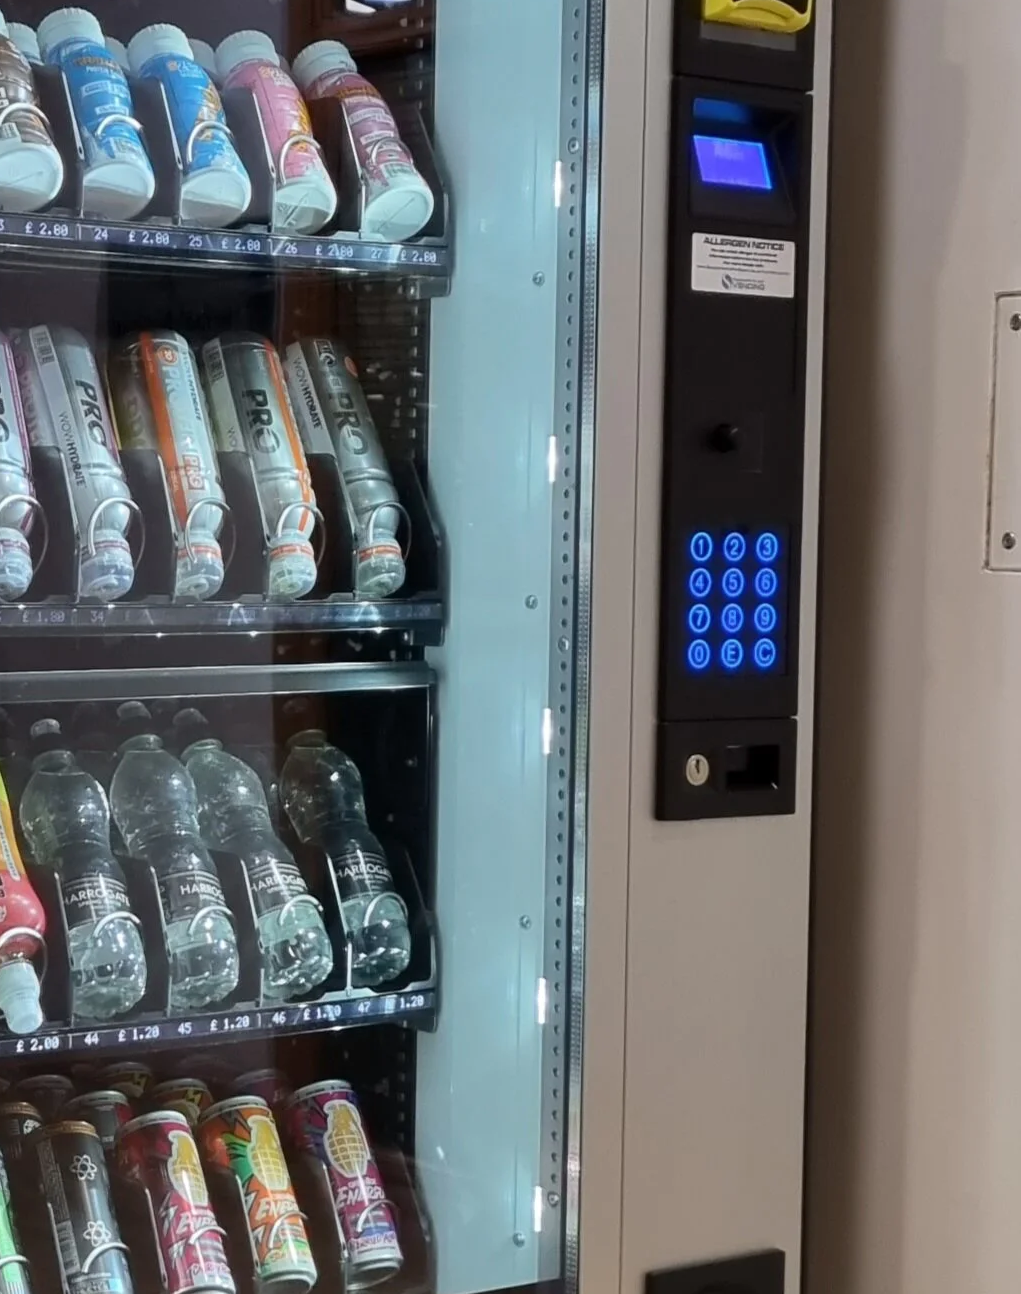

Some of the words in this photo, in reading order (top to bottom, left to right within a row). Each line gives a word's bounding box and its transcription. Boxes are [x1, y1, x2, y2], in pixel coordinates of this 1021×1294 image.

[94, 227, 108, 240] 24
[189, 235, 202, 247] 25
[285, 242, 298, 254] 26
[703, 237, 751, 248] ALLERGEN
[752, 241, 784, 251] NOTICE
[293, 357, 322, 430] WOWHYDRATE
[75, 379, 107, 448] PRO
[242, 389, 281, 455] PRO
[329, 392, 369, 456] PRO
[59, 410, 87, 487] WOWHYDRATE
[697, 539, 705, 555] 1
[730, 539, 739, 556] 2
[762, 539, 772, 556] 3
[695, 575, 705, 591] 4
[729, 575, 738, 591] 5
[761, 575, 770, 591] 6
[695, 611, 704, 626] 7
[728, 611, 737, 626] 8
[761, 610, 770, 625] 9
[727, 646, 736, 661] E
[760, 645, 771, 660] C
[358, 1001, 371, 1014] 47
[272, 1011, 287, 1024] 46
[178, 1022, 193, 1035] 45
[84, 1033, 99, 1045] 44
